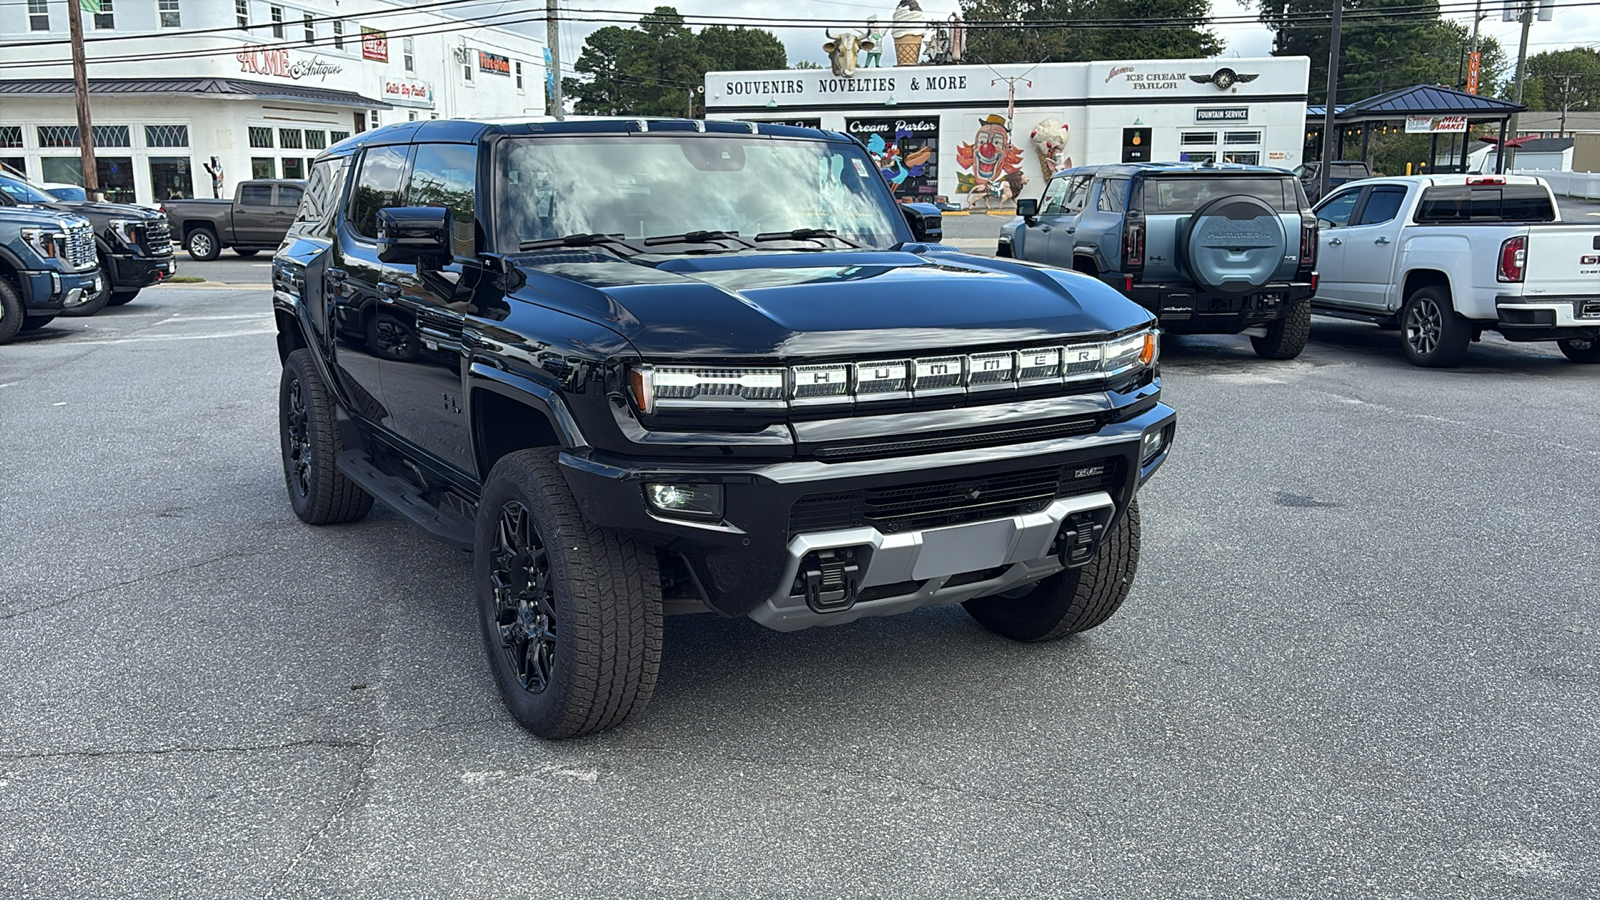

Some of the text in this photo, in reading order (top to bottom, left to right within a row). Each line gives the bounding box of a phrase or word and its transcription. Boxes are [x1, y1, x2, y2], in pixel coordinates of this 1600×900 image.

[237, 44, 291, 77] ACME
[1125, 73, 1186, 82] ICE CREAM
[727, 76, 967, 95] SOUVENIRS NOVELTIES & MORE
[1133, 82, 1178, 90] PARLOR
[1198, 109, 1247, 119] FOUNTAIN SERVICE
[849, 120, 937, 133] Cream Parlor
[1436, 123, 1465, 131] SHAKES
[814, 351, 1089, 383] HUMMER
[1075, 466, 1104, 478] GMC
